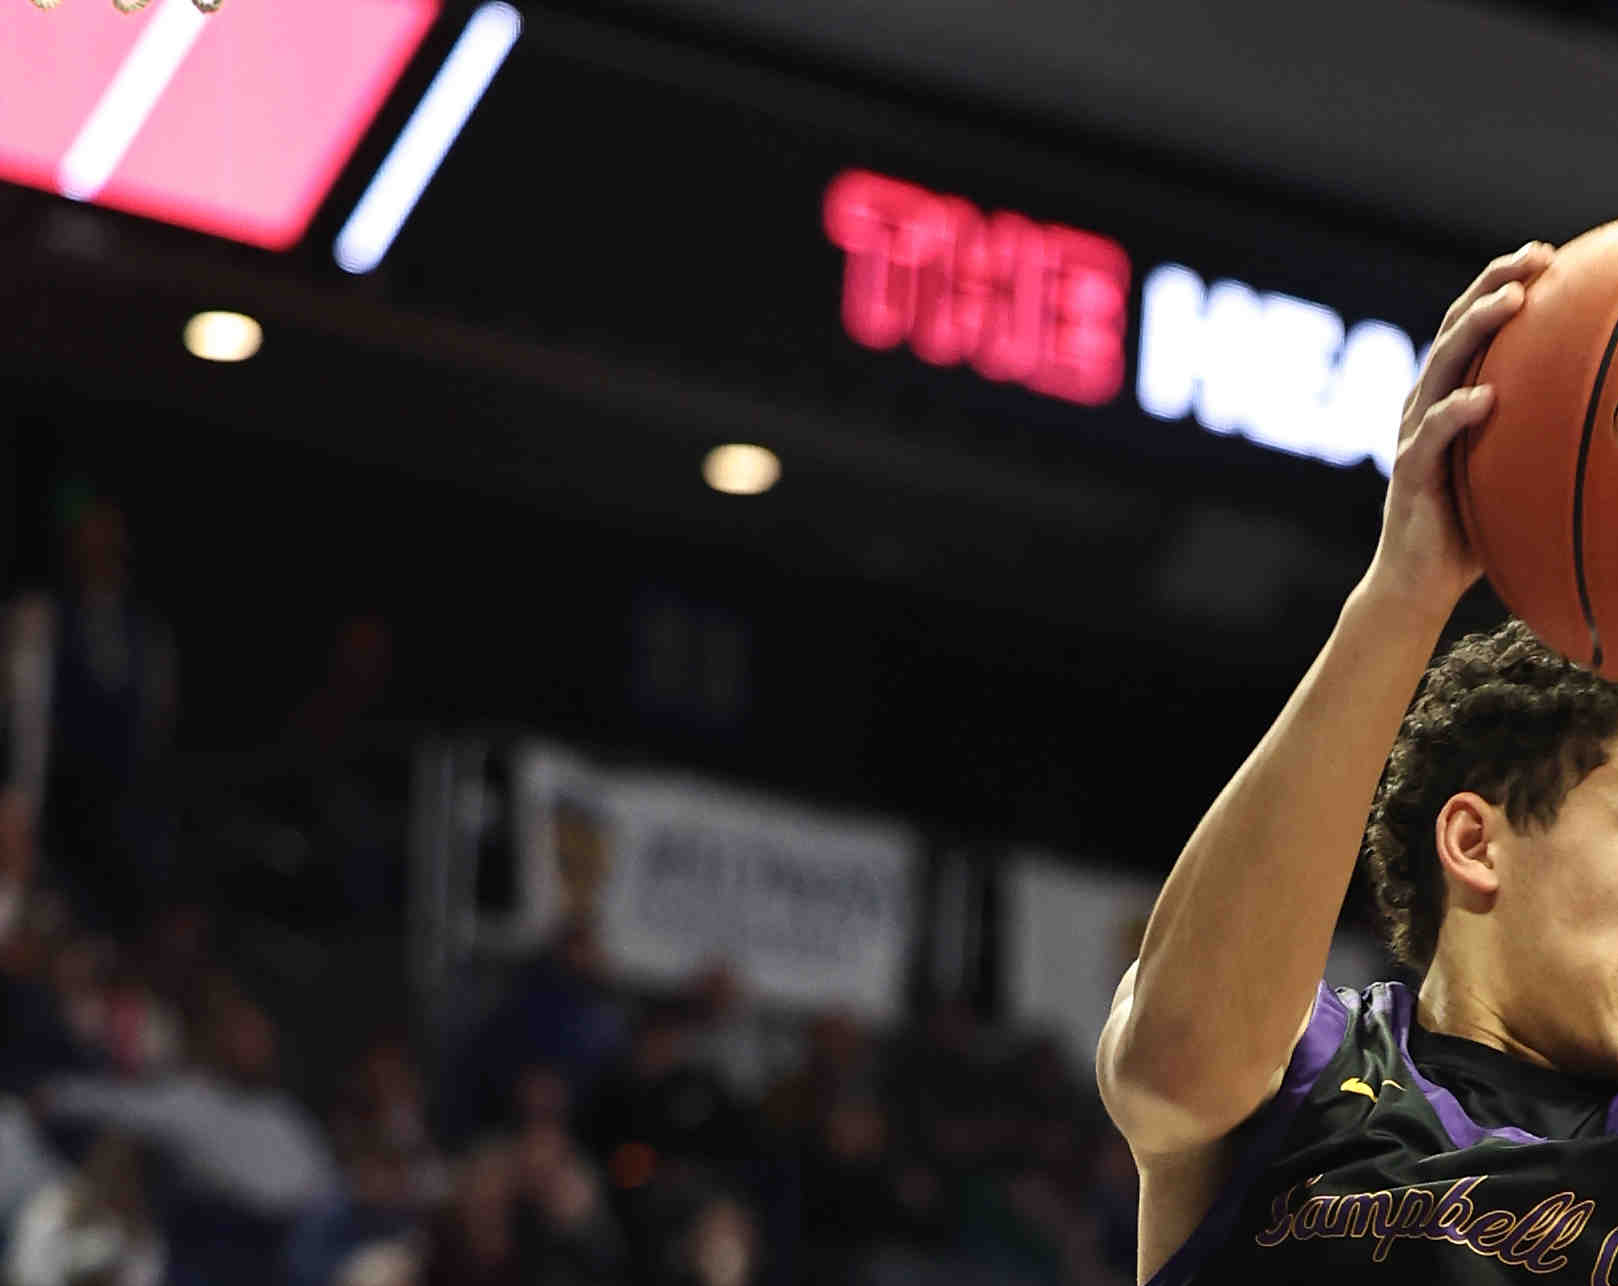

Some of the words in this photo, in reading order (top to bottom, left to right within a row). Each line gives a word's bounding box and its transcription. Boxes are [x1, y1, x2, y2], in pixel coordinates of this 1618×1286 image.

[821, 165, 1132, 408] THE
[1136, 260, 1432, 479] HEA
[1255, 1173, 1597, 1275] Campbell
